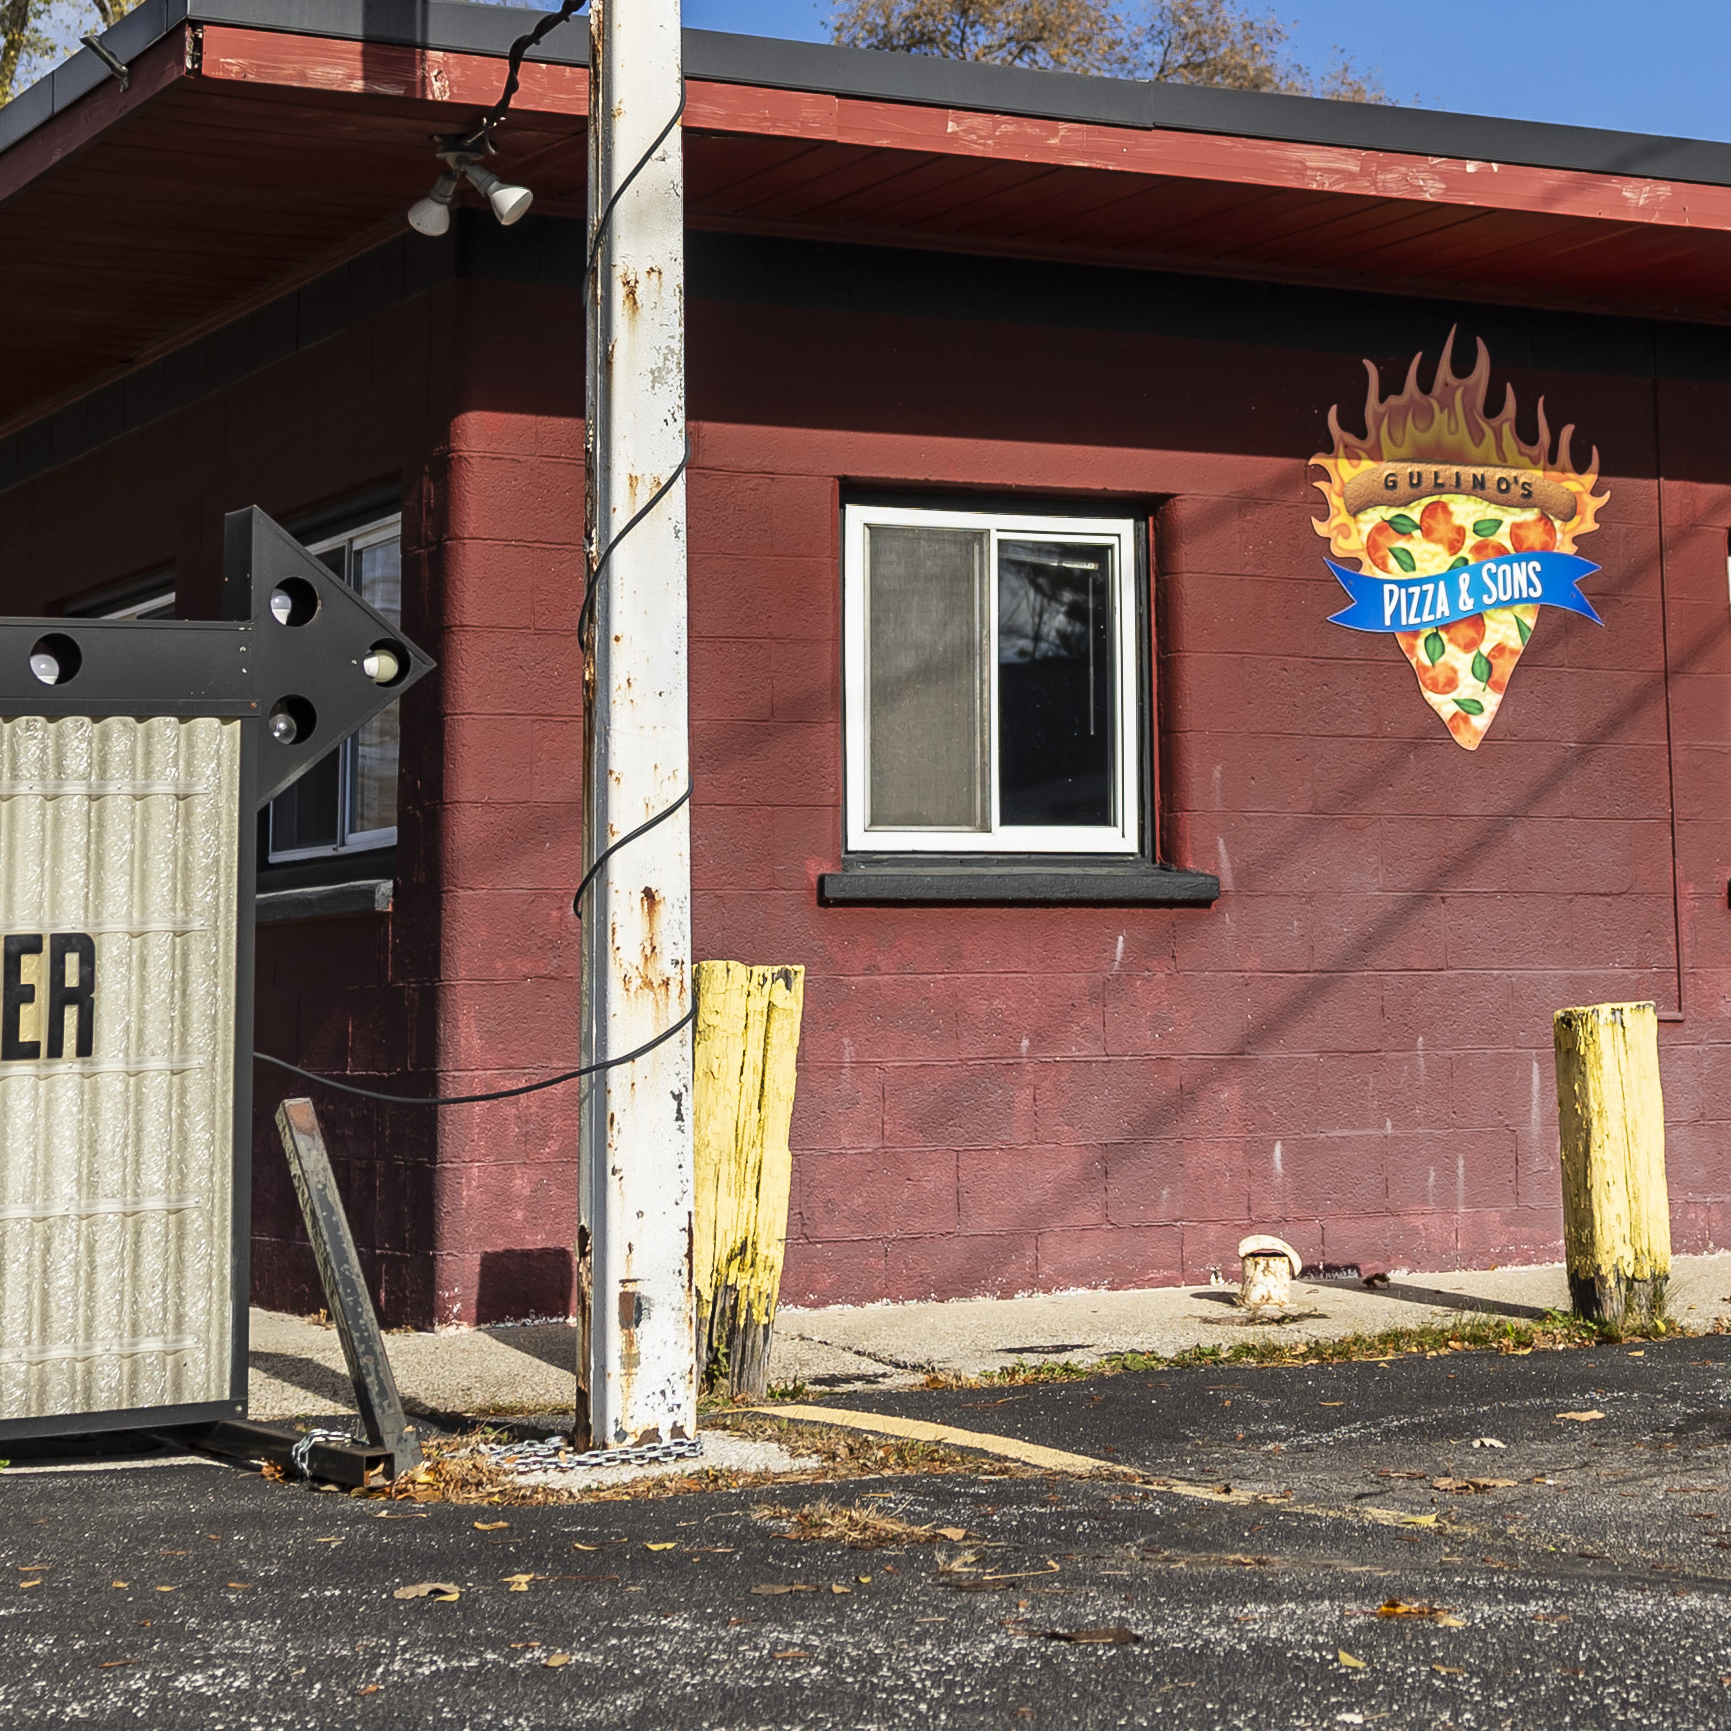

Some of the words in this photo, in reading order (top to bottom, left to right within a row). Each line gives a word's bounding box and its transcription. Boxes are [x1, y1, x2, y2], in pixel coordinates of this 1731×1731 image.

[1382, 470, 1534, 500] GULINO'S
[1383, 582, 1450, 627] PIZZA
[1458, 572, 1475, 612] &
[1482, 560, 1543, 606] SONS
